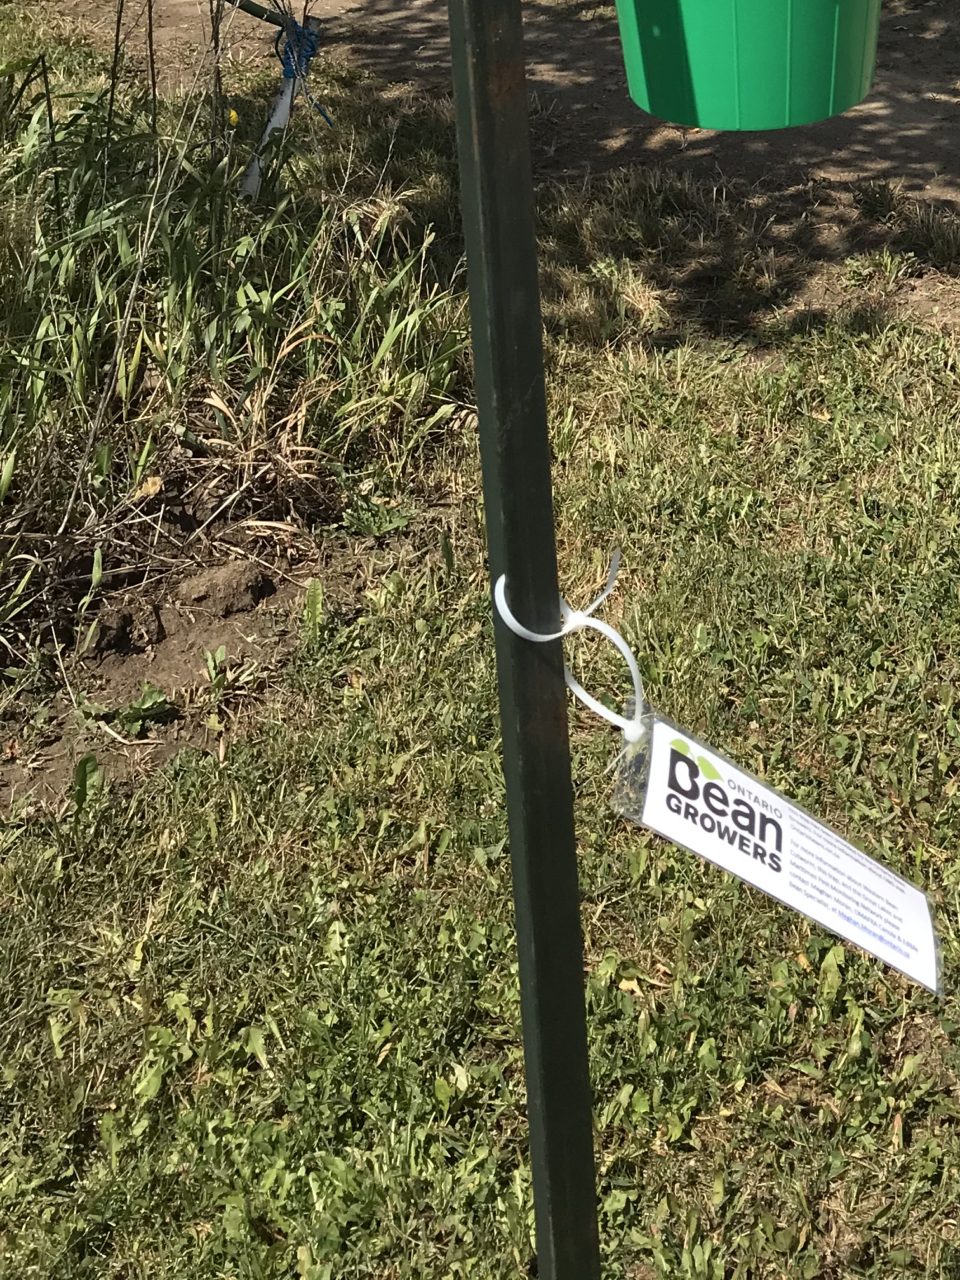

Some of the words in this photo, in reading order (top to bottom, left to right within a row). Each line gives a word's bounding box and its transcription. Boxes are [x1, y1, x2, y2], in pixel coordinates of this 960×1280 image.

[665, 793, 782, 873] GROWERS
[667, 747, 783, 853] Bean
[727, 779, 783, 819] ONTARIO
